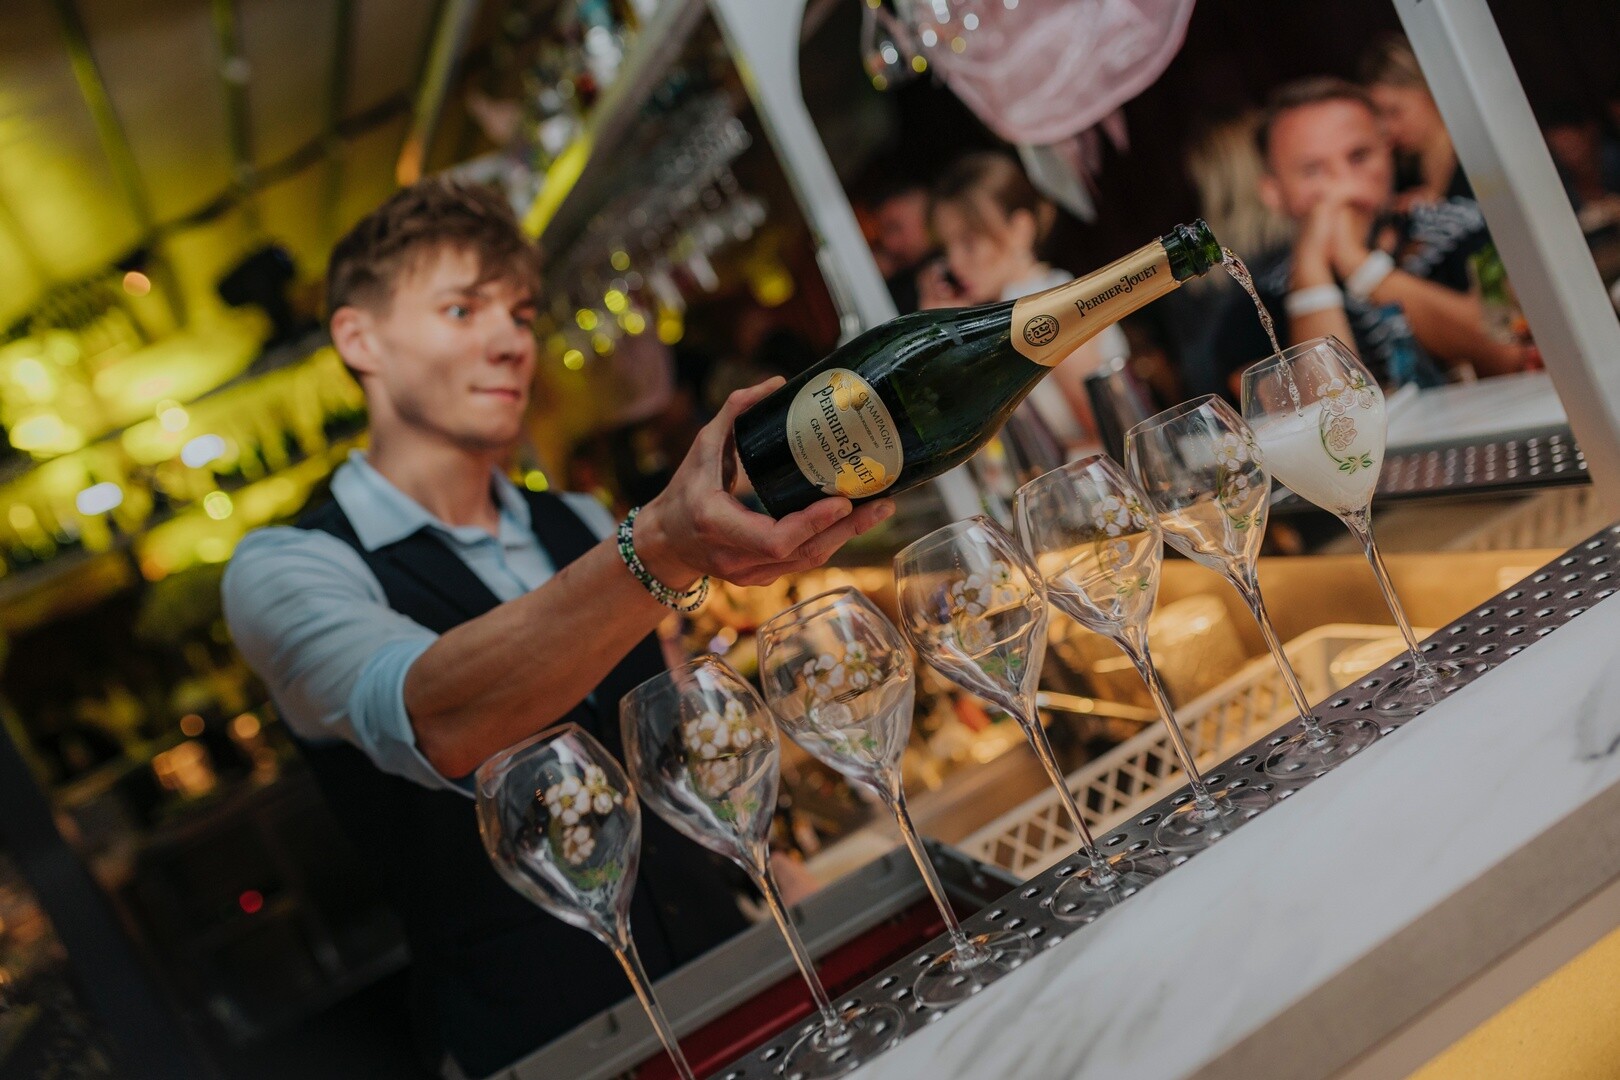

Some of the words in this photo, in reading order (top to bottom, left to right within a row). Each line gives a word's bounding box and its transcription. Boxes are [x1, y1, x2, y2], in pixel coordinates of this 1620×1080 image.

[810, 418, 830, 452] GRAND
[826, 452, 845, 475] BRUT
[812, 384, 876, 484] PERRIER-JOUËT
[858, 392, 894, 450] CHAMPAGNE
